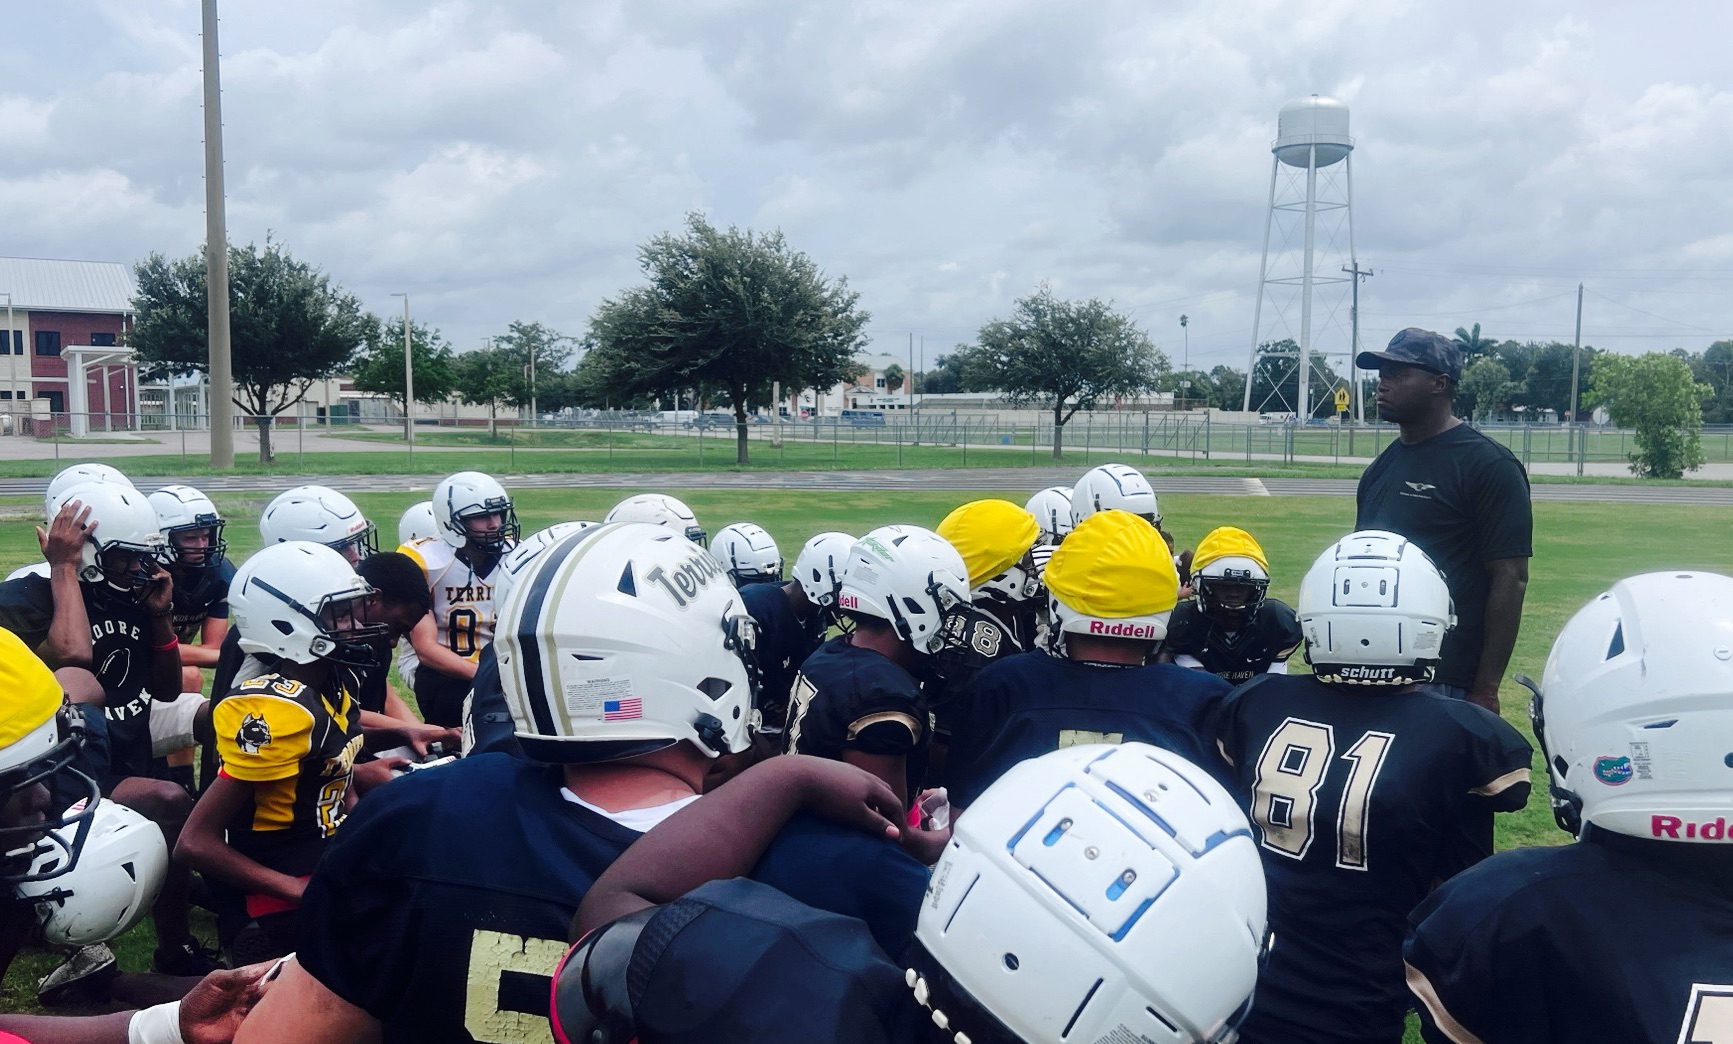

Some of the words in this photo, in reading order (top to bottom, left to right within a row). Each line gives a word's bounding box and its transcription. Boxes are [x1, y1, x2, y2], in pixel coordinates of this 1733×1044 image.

[645, 545, 722, 609] Terri
[445, 586, 494, 602] TERRI
[91, 620, 140, 646] OORE
[1089, 620, 1155, 639] Riddell
[1341, 665, 1396, 679] schutt
[104, 687, 152, 721] AVEN
[1249, 716, 1396, 872] 81
[1651, 814, 1733, 841] Rid
